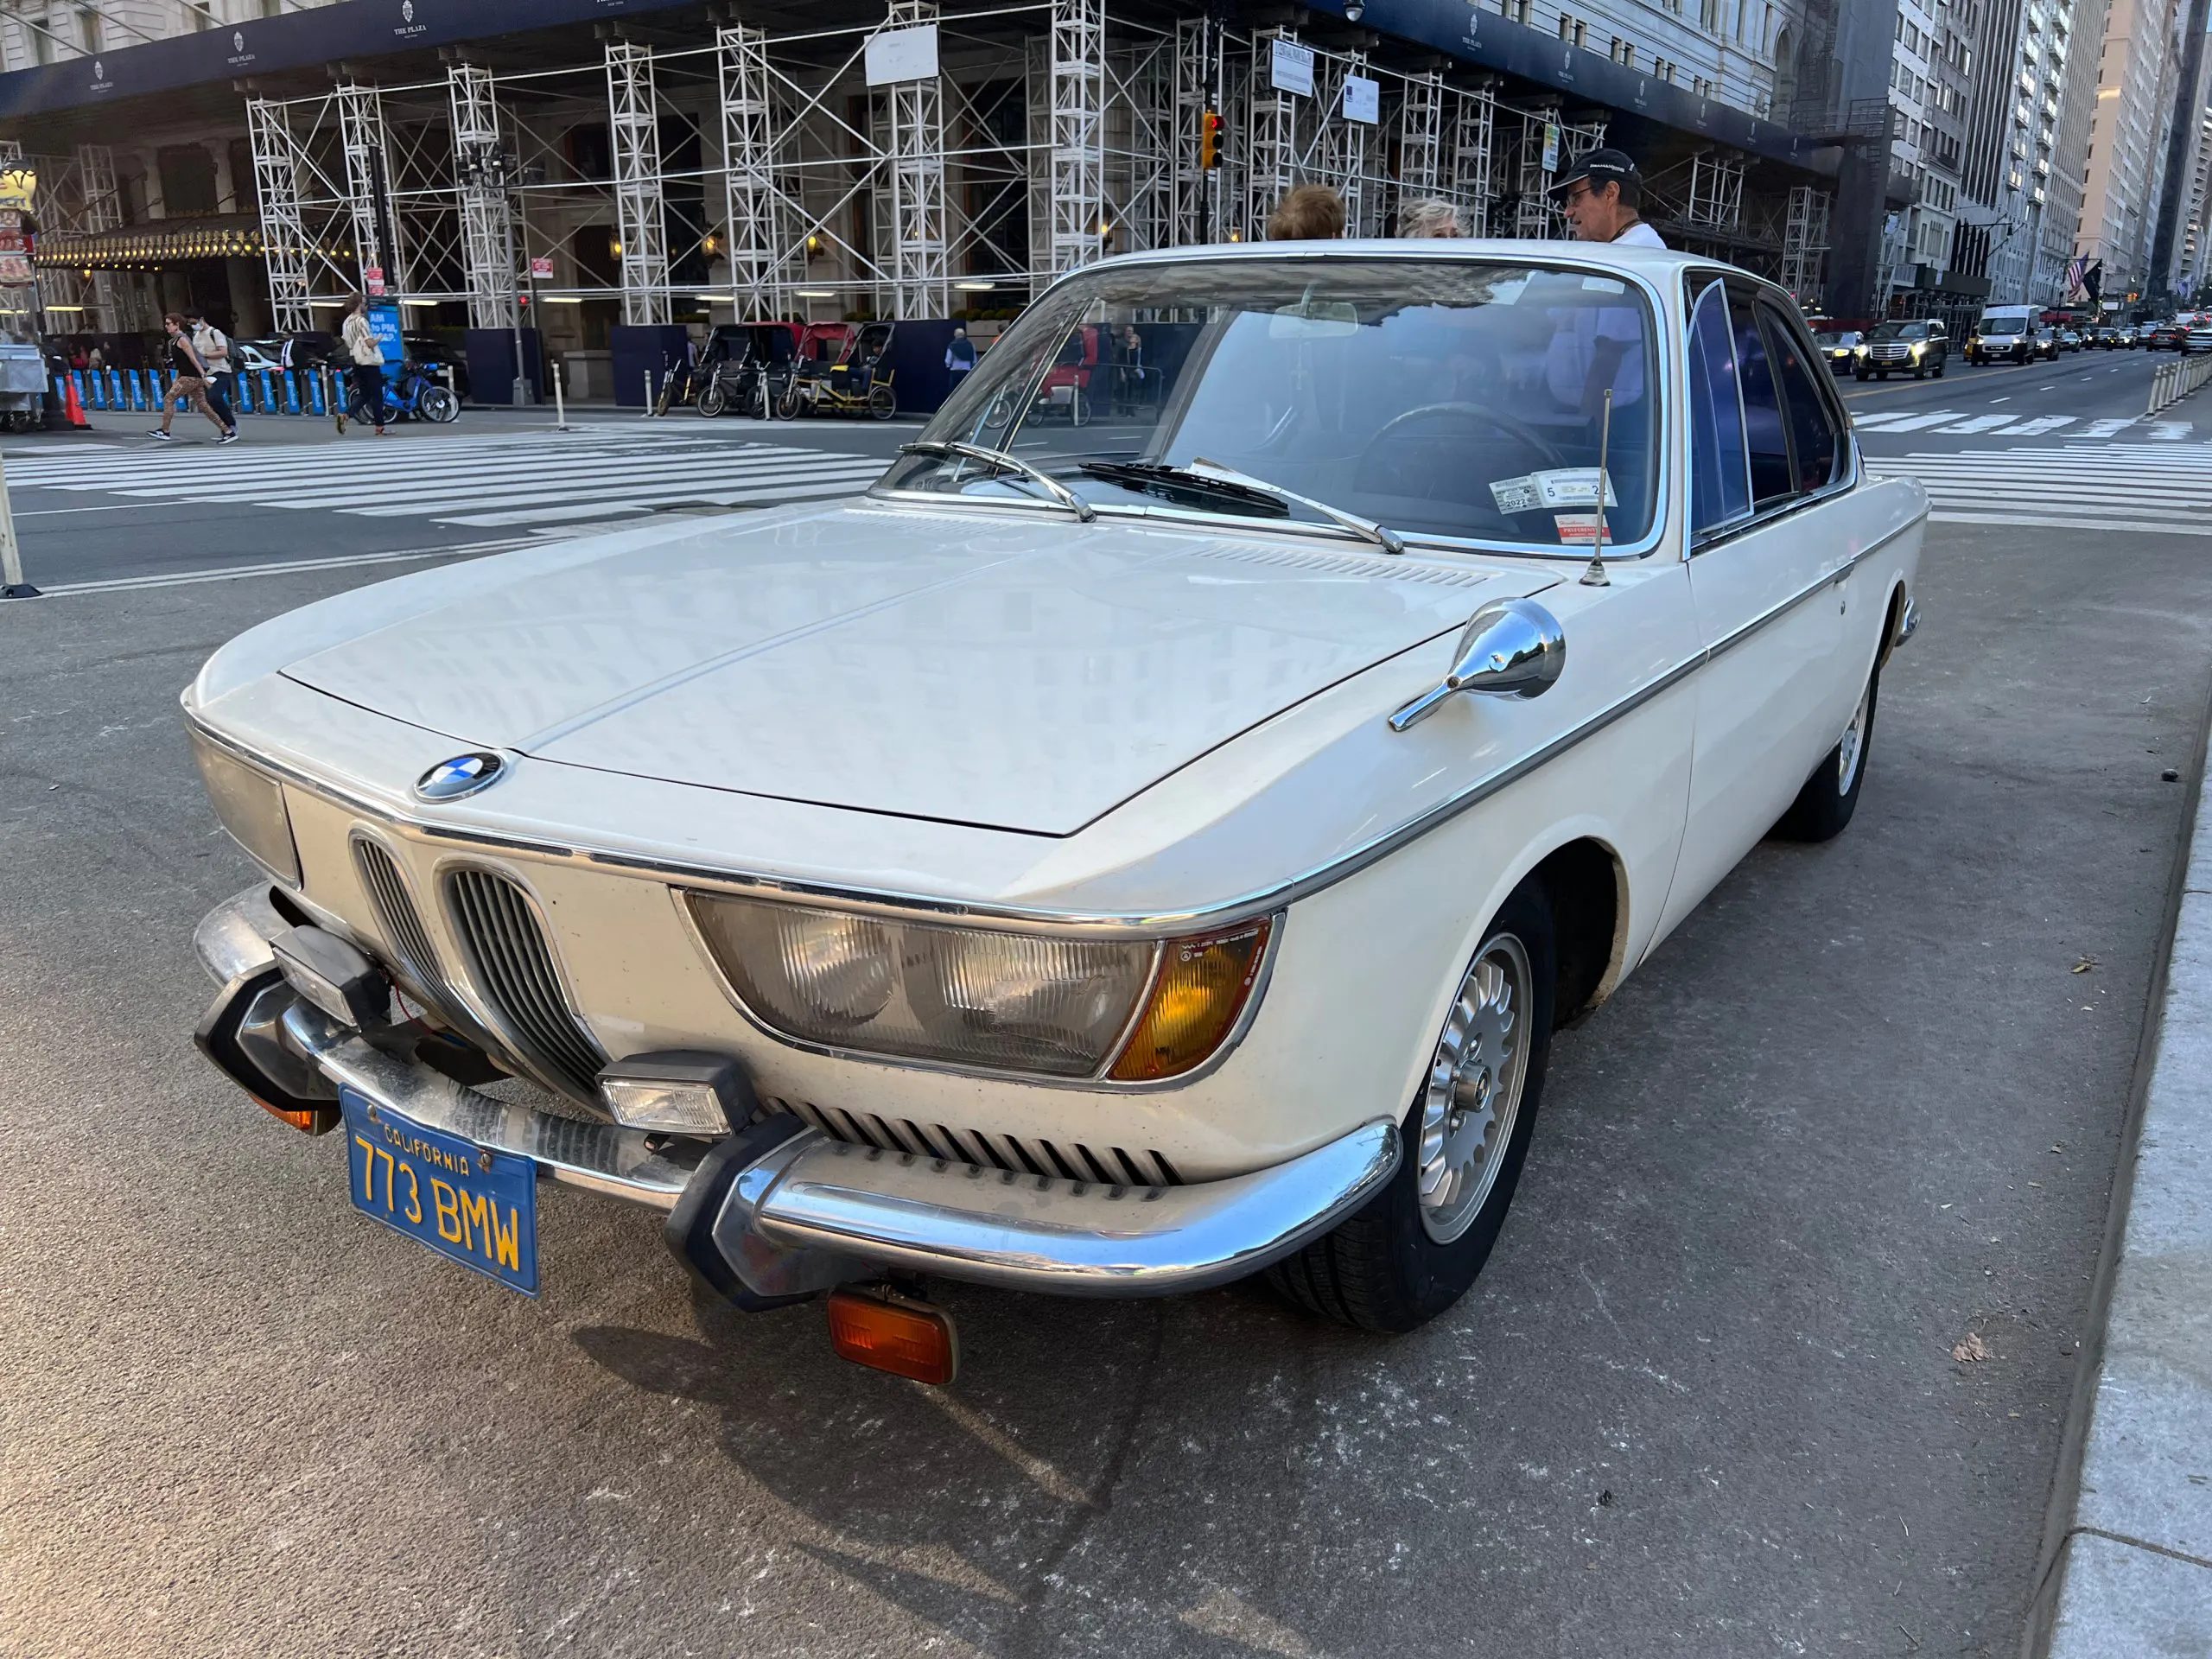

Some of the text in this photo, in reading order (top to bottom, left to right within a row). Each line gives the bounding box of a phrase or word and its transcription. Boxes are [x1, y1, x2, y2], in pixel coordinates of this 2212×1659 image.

[407, 24, 427, 34] PLAZA
[370, 314, 385, 323] AM
[371, 323, 397, 334] to PM,
[1547, 485, 1608, 497] 5 2
[1506, 498, 1526, 507] 2022
[385, 1123, 470, 1177] CALIFORNIA
[355, 1135, 519, 1272] 773 BMW
